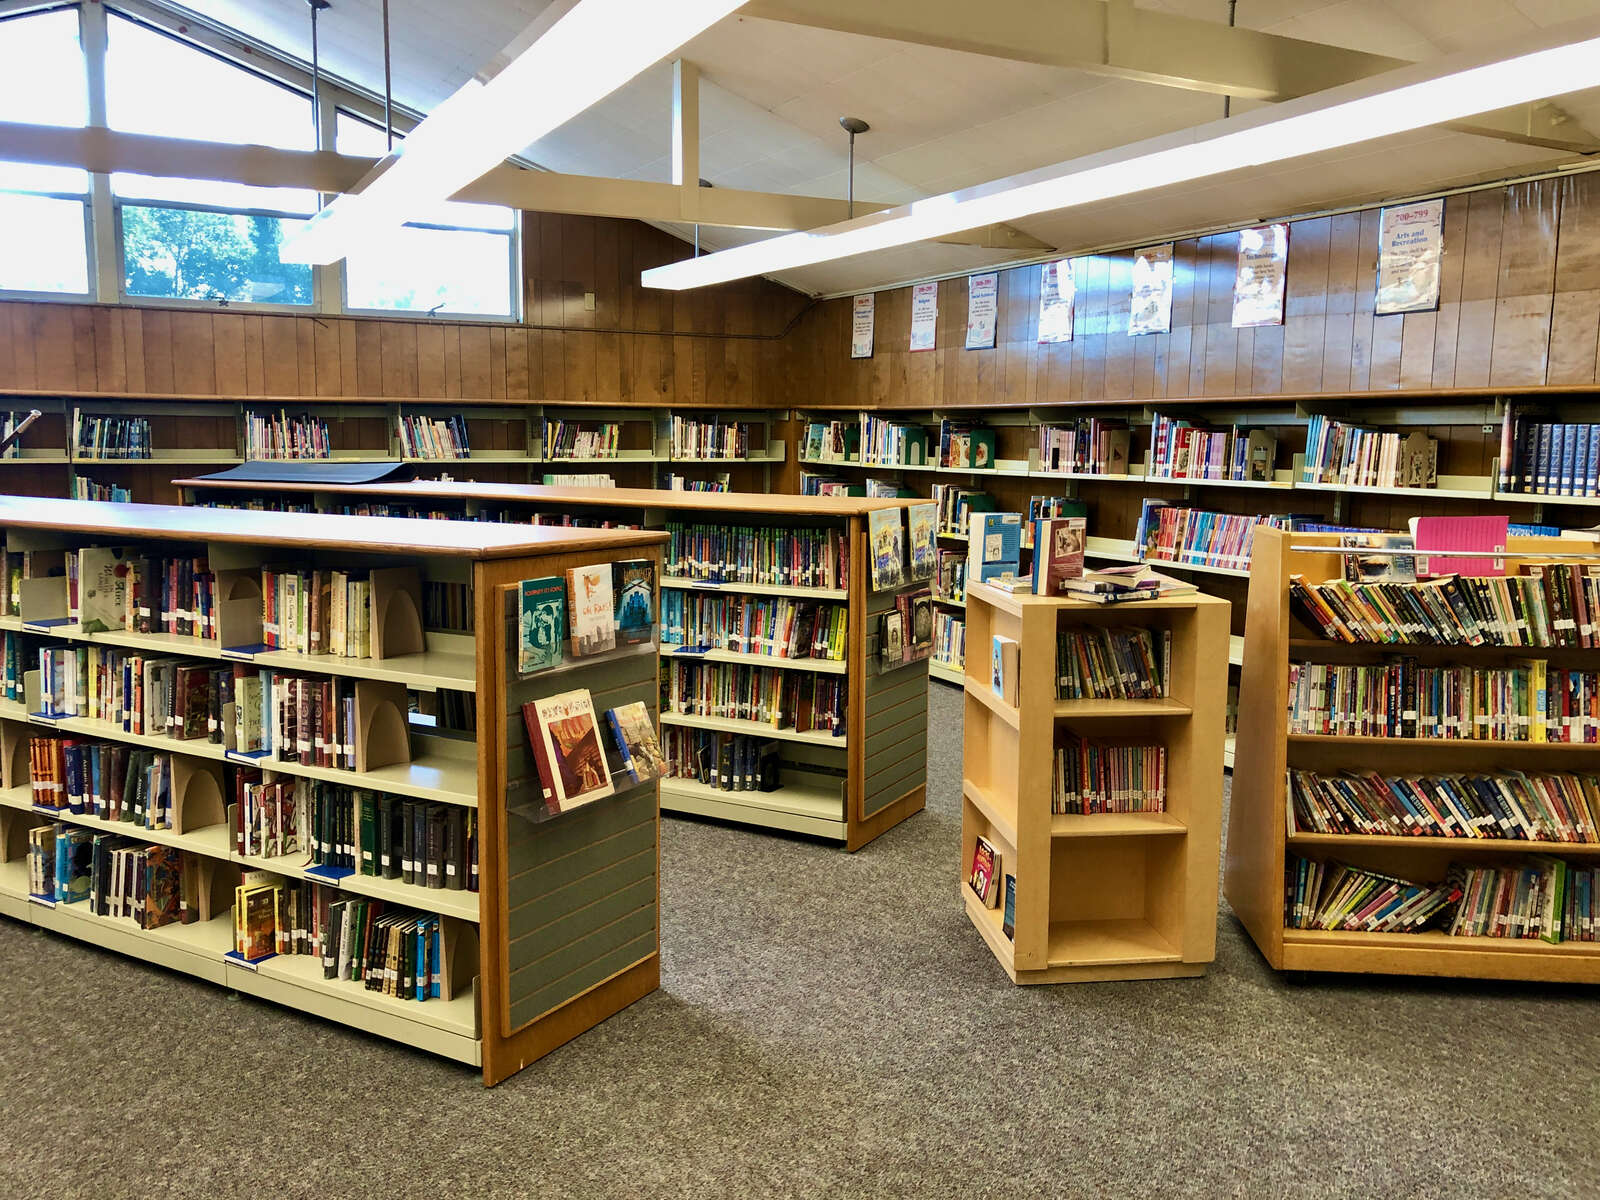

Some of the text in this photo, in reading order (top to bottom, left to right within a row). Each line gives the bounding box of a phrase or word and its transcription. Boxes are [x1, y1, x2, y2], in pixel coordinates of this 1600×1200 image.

[1392, 237, 1428, 248] Recreation
[1396, 229, 1425, 240] Arts and
[1409, 794, 1428, 819] RESISTAN
[1496, 794, 1514, 819] RESISTAN
